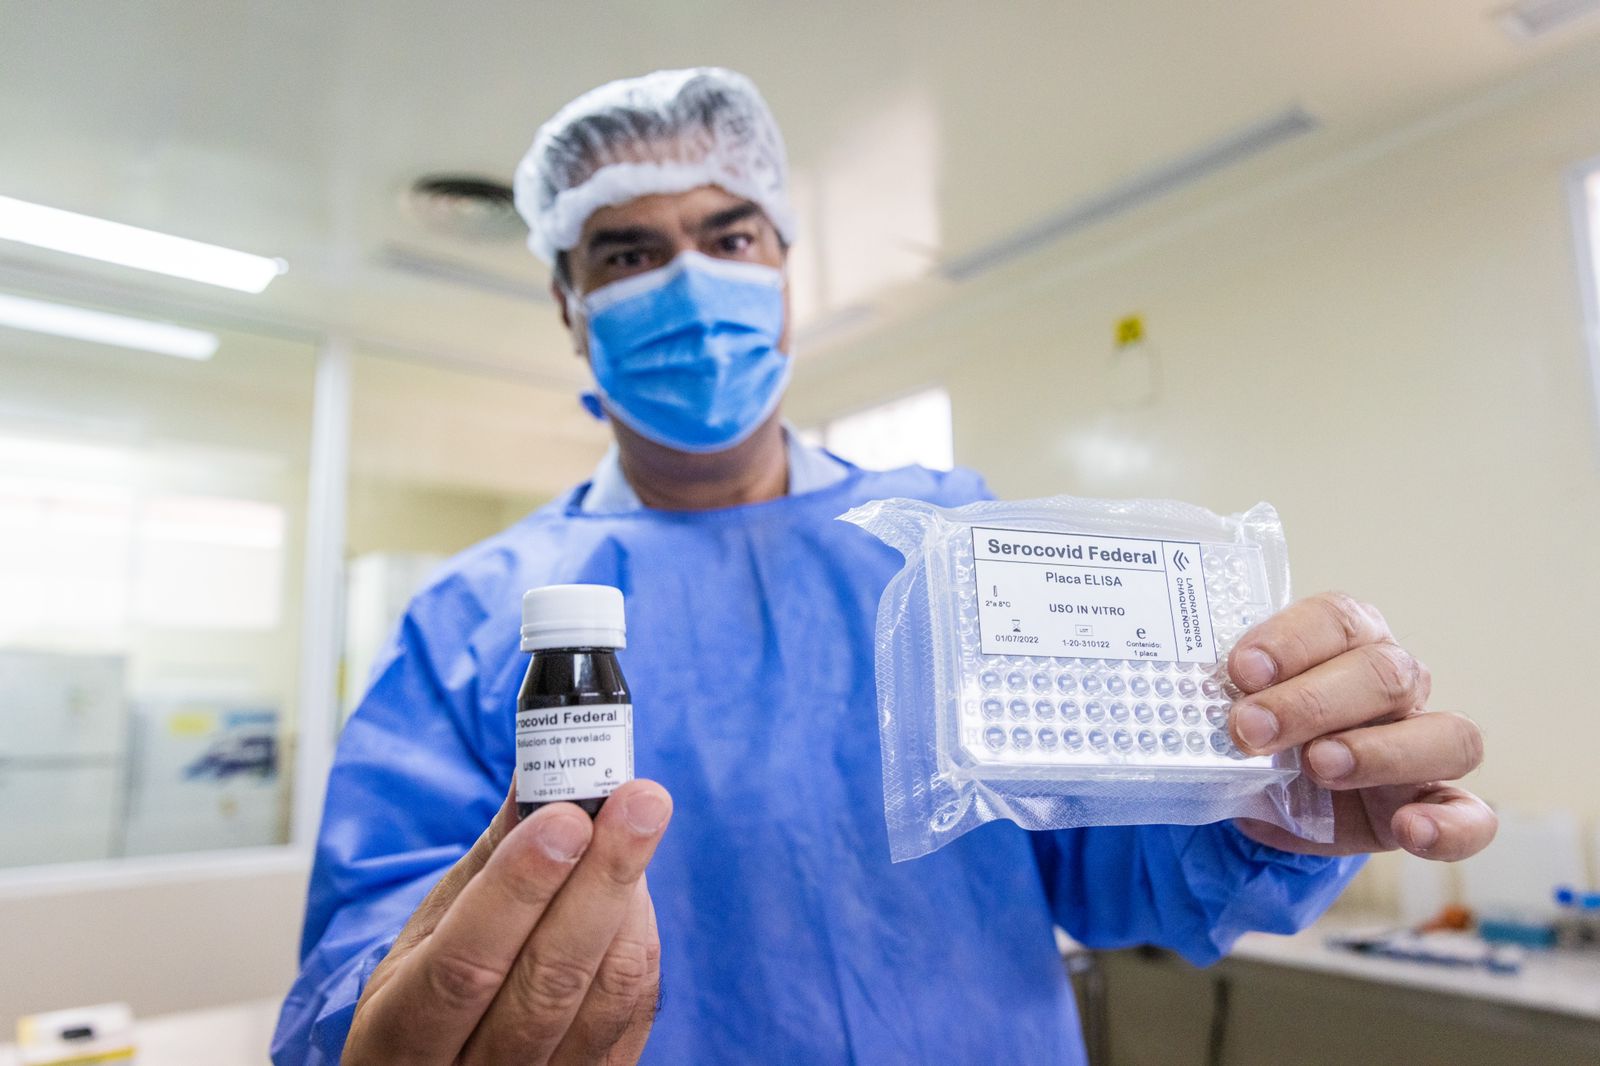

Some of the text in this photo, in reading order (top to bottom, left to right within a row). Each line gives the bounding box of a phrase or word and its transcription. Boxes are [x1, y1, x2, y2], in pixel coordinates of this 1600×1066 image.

[988, 538, 1083, 560] Serocovid
[1088, 545, 1157, 565] Federal
[1045, 571, 1123, 587] Placa ELISA
[1049, 603, 1125, 616] USO IN VITRO
[1176, 577, 1191, 635] CHAQUEÑOS
[1185, 577, 1203, 648] LABORATORIOS
[995, 634, 1039, 644] 01/07/2022
[1062, 639, 1110, 648] 1-20-310122
[1126, 640, 1162, 649] Contenido:
[1139, 650, 1158, 658] placa
[563, 710, 617, 724] Federal
[549, 735, 562, 745] de
[565, 732, 611, 744] revelado
[523, 757, 596, 772] USO IN VITRO
